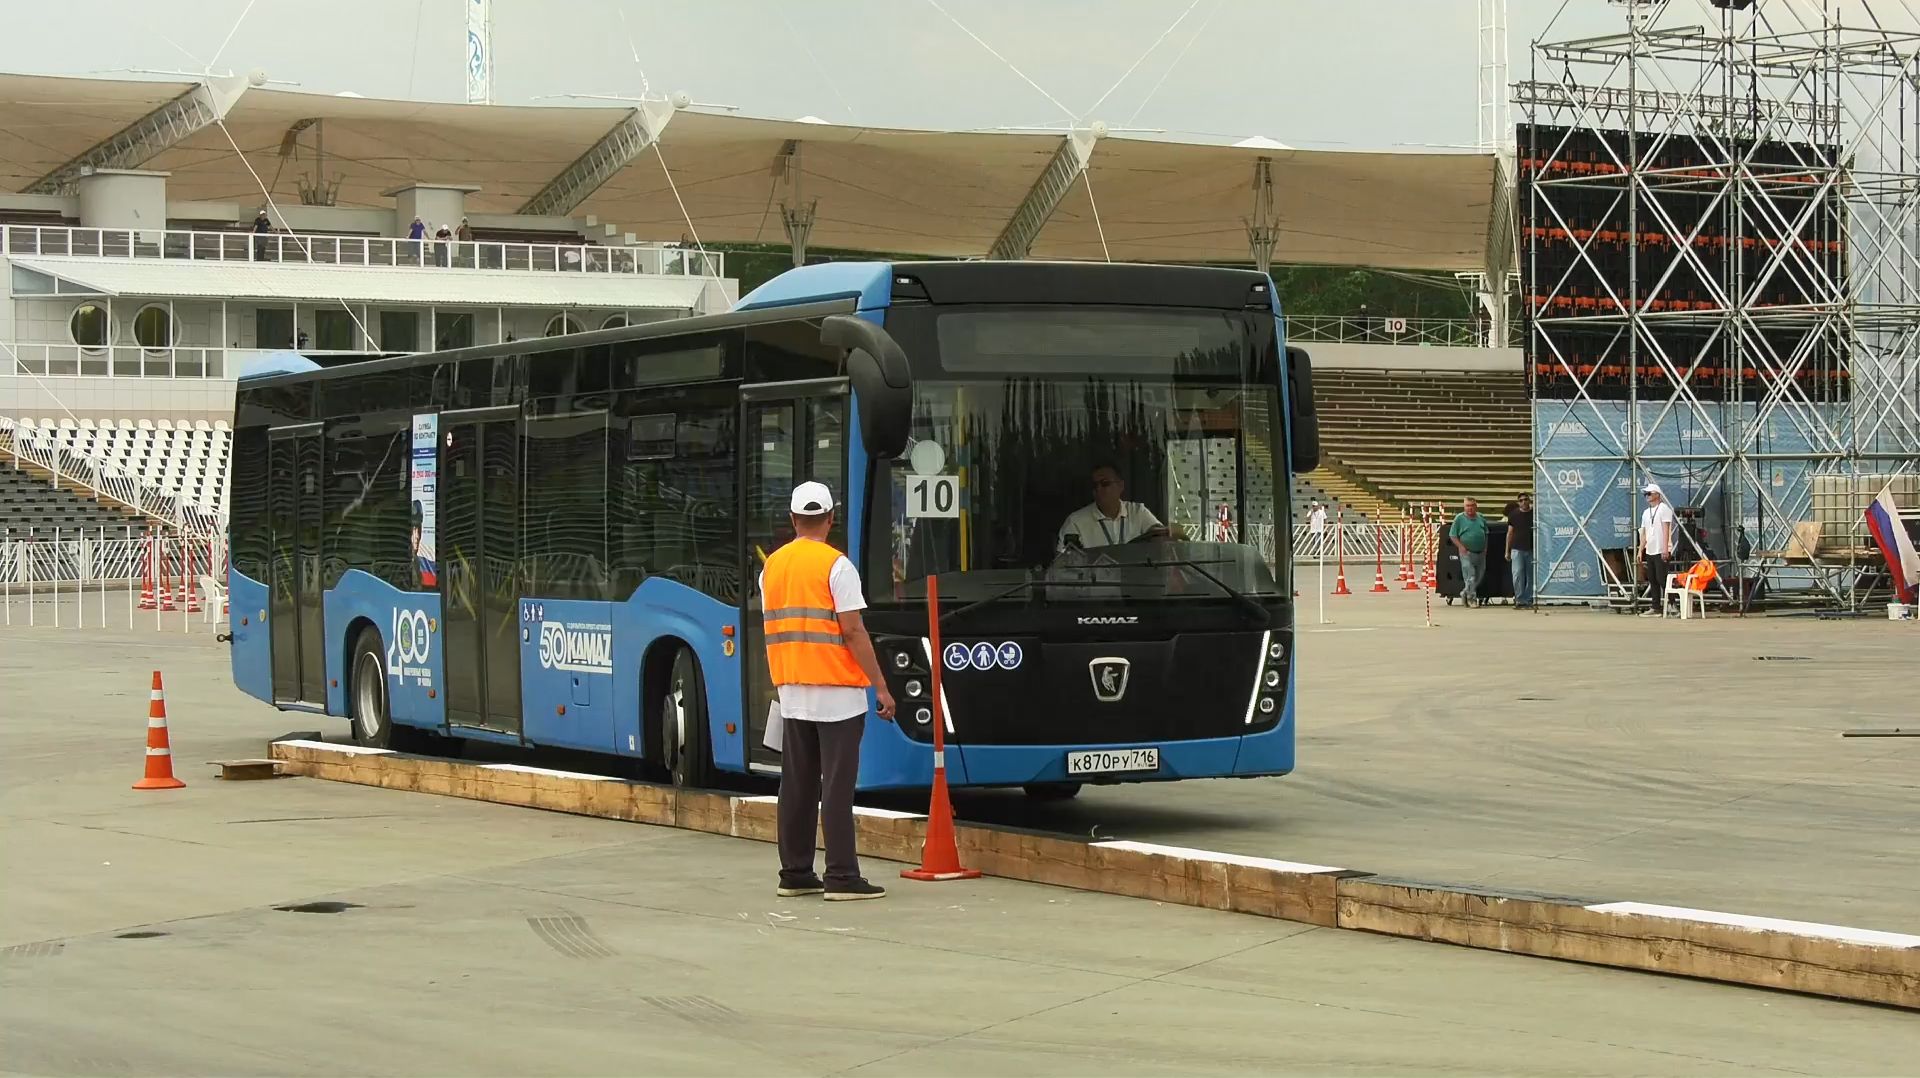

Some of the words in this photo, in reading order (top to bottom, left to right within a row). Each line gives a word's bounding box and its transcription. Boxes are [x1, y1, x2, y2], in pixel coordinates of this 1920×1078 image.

[1388, 320, 1403, 331] 10
[913, 479, 953, 512] 10
[1077, 616, 1139, 624] KAMAZ
[540, 621, 567, 670] 50
[567, 632, 612, 666] KAMAZ
[1073, 753, 1129, 771] К870РУ
[1132, 750, 1154, 764] 716
